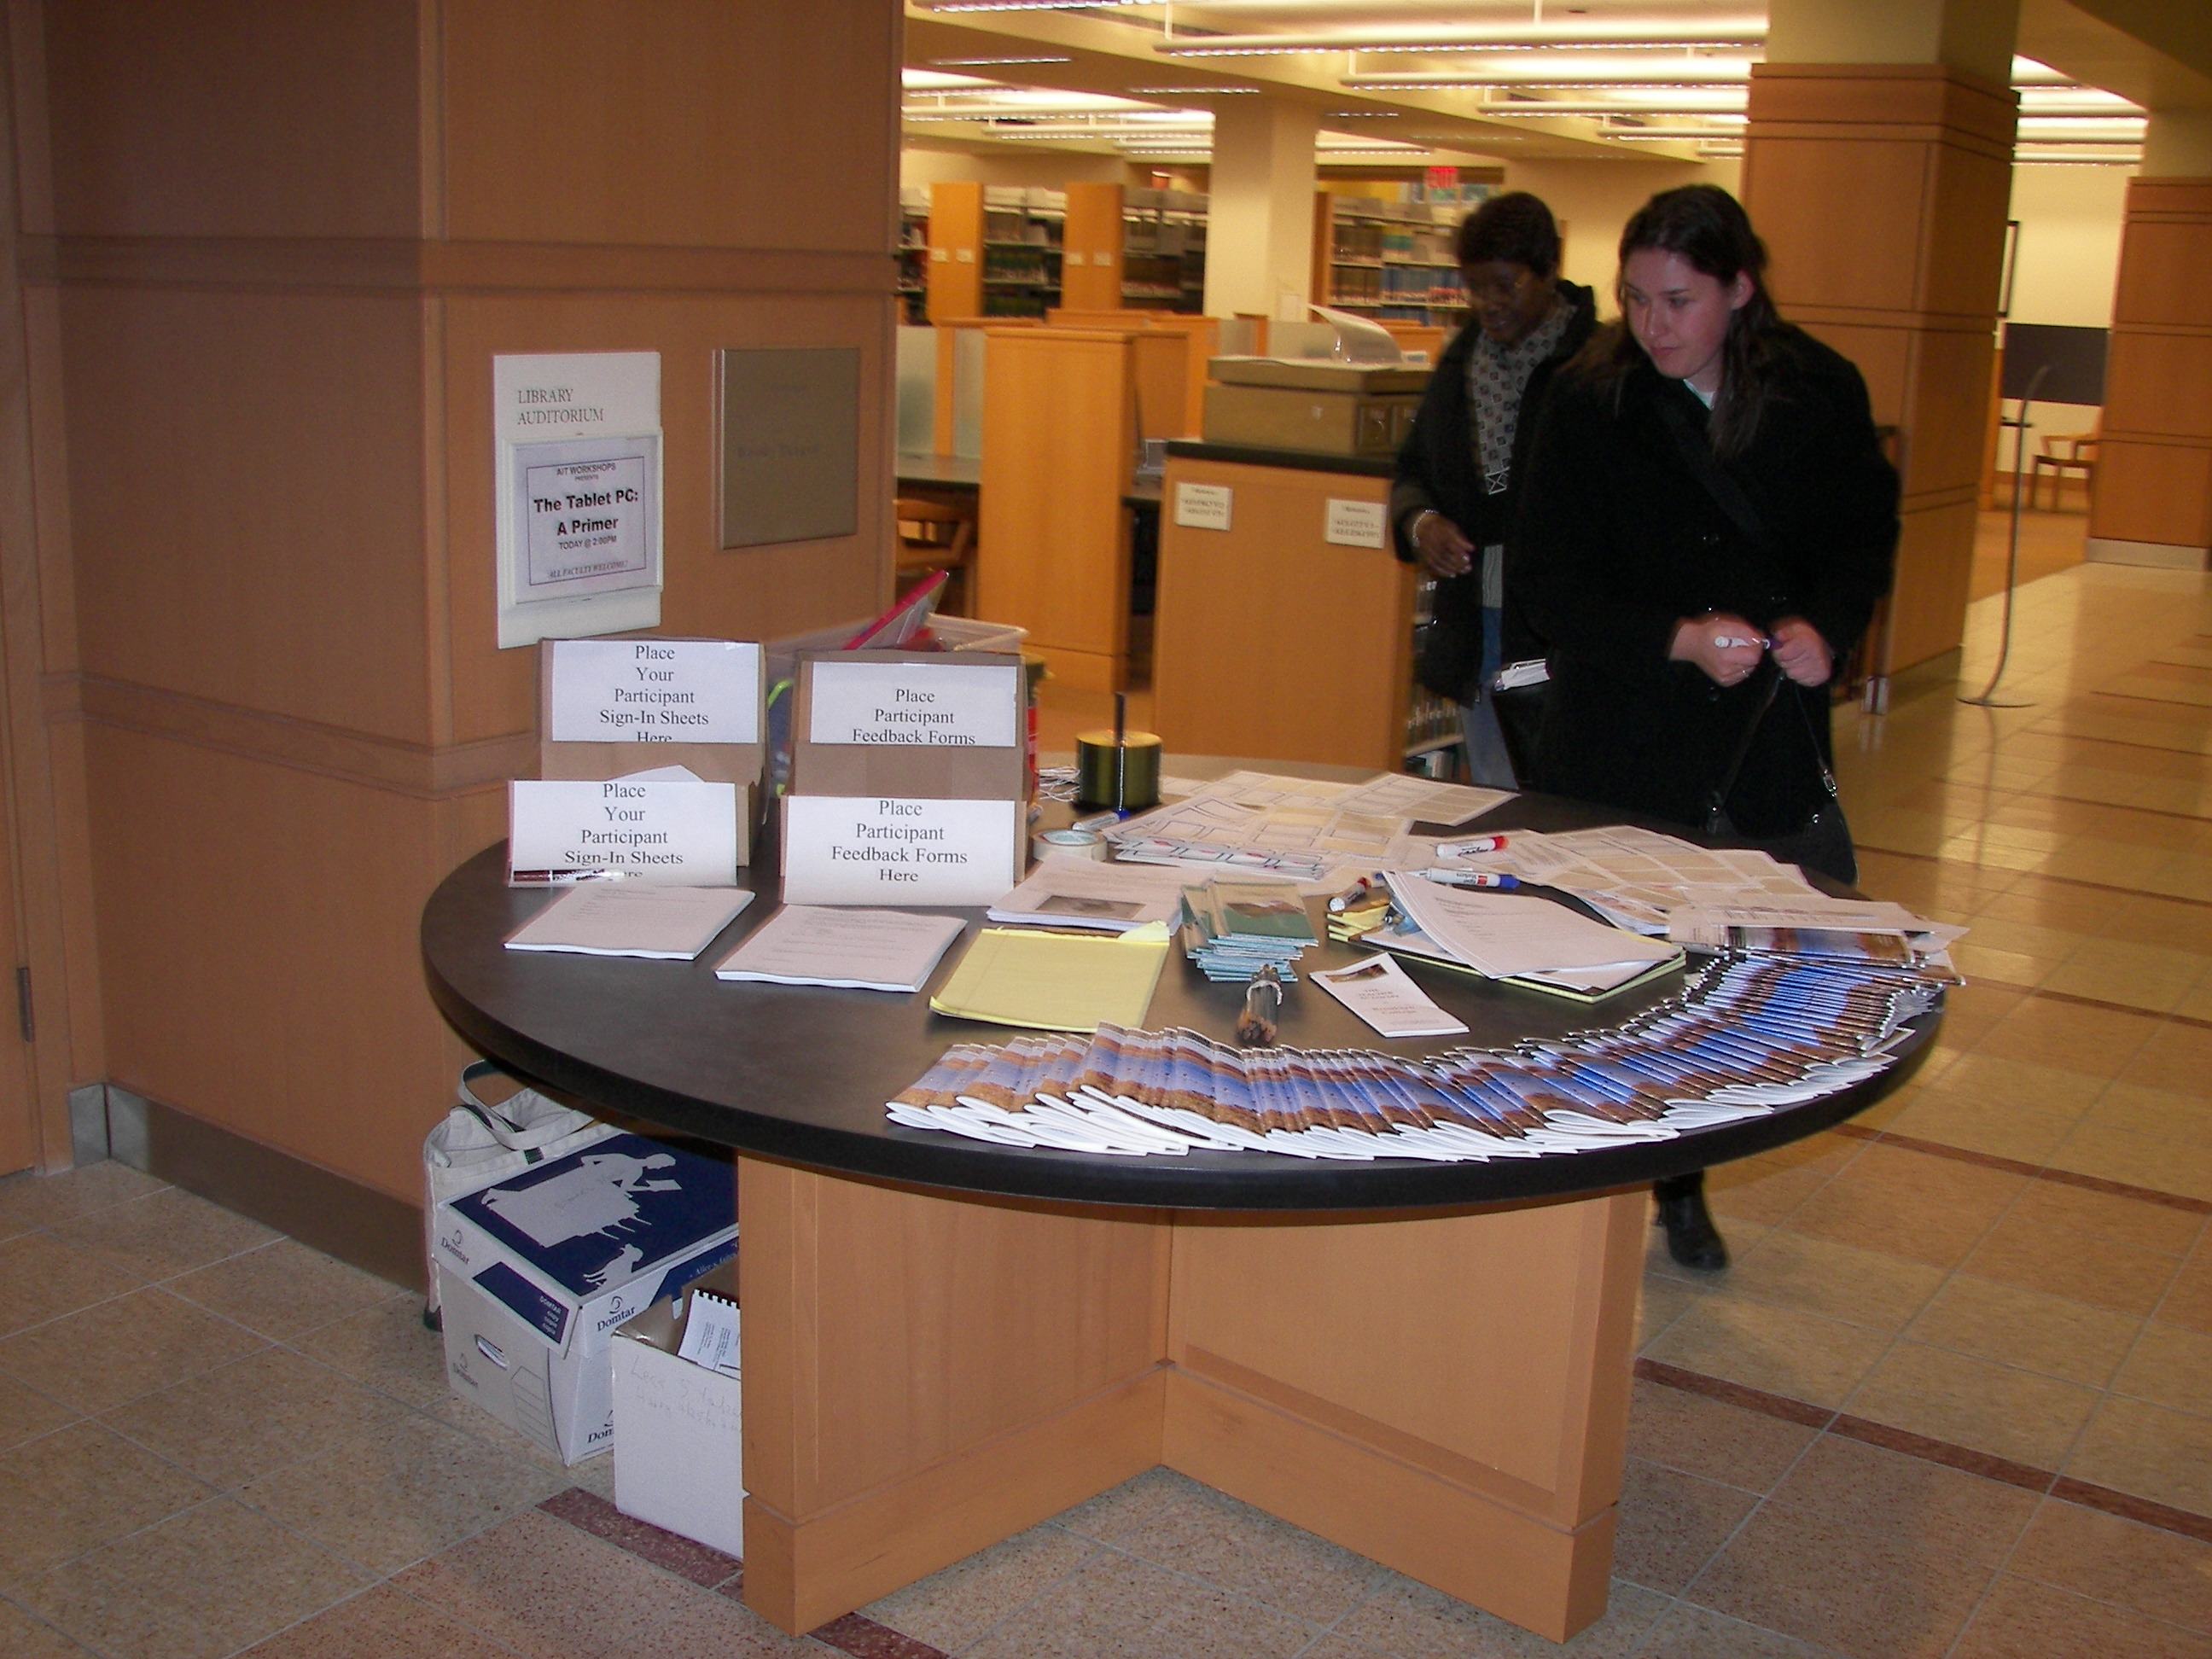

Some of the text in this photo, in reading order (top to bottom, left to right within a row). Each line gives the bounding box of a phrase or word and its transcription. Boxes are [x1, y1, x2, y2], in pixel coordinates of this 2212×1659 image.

[517, 388, 573, 404] LIBRARY
[517, 408, 604, 426] AUDITORIUM
[569, 463, 616, 474] WORKSHOPS
[533, 488, 638, 513] The Tablet PC:
[557, 518, 619, 536] A Primer
[558, 540, 584, 550] TODAY
[635, 645, 676, 661] Place
[636, 667, 674, 682] Your
[614, 689, 696, 707] Participant
[895, 689, 935, 703] Place
[600, 710, 709, 727] Sign-In Sheets
[875, 708, 955, 726] Participant
[853, 729, 976, 745] Feedback Forms
[602, 783, 646, 798] Place
[604, 806, 646, 822] Your
[879, 800, 923, 816] Place
[581, 830, 668, 847] Participant
[856, 824, 945, 844] Participant
[565, 851, 684, 867] Sign-In Sheets
[831, 846, 968, 864] Feedback Forms
[879, 869, 919, 882] Here
[441, 1237, 469, 1265] Domtar
[597, 1307, 636, 1332] Domtar
[587, 1429, 614, 1444] Dom
